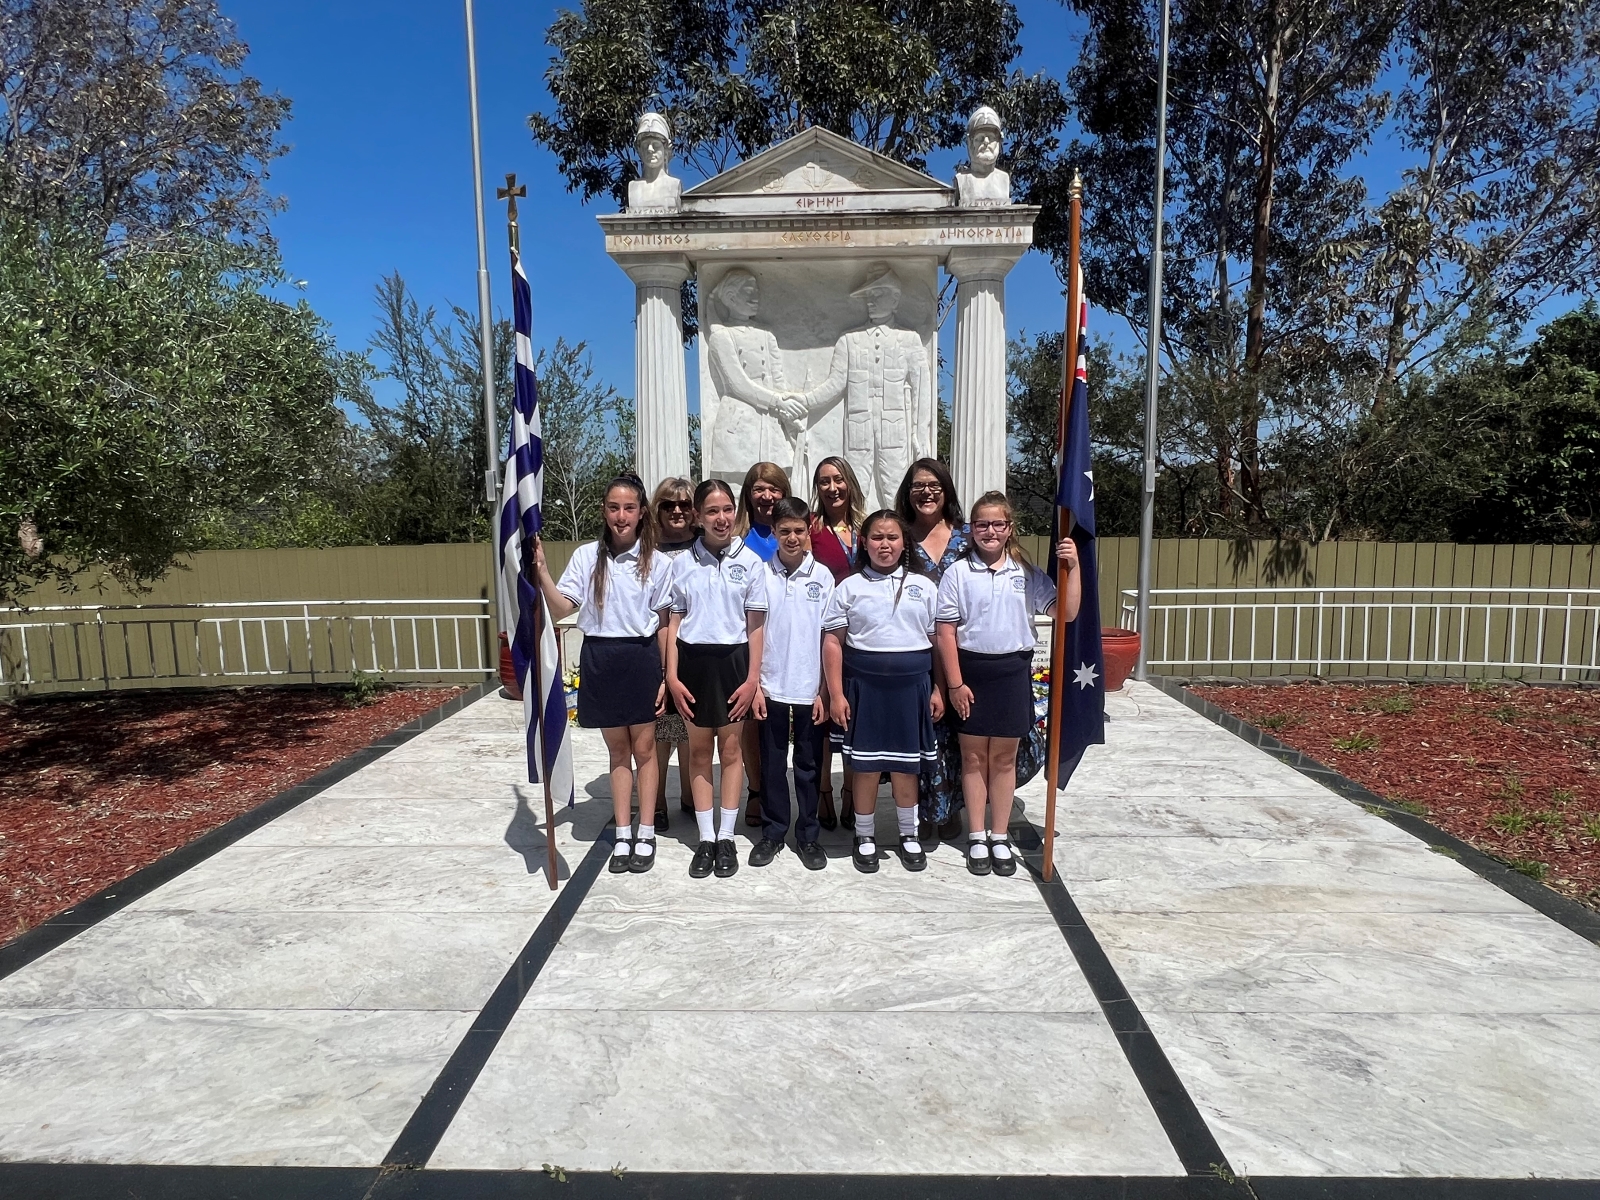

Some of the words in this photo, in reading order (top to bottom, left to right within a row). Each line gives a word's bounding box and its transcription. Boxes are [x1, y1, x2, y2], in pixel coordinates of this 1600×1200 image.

[796, 196, 844, 208] ΕΙΡΗΝΗ
[781, 231, 851, 243] ΕΛΕΥΘΕΡΙΑ
[939, 226, 1023, 240] ΔΗΜΟΚΡΑΤΙΑ
